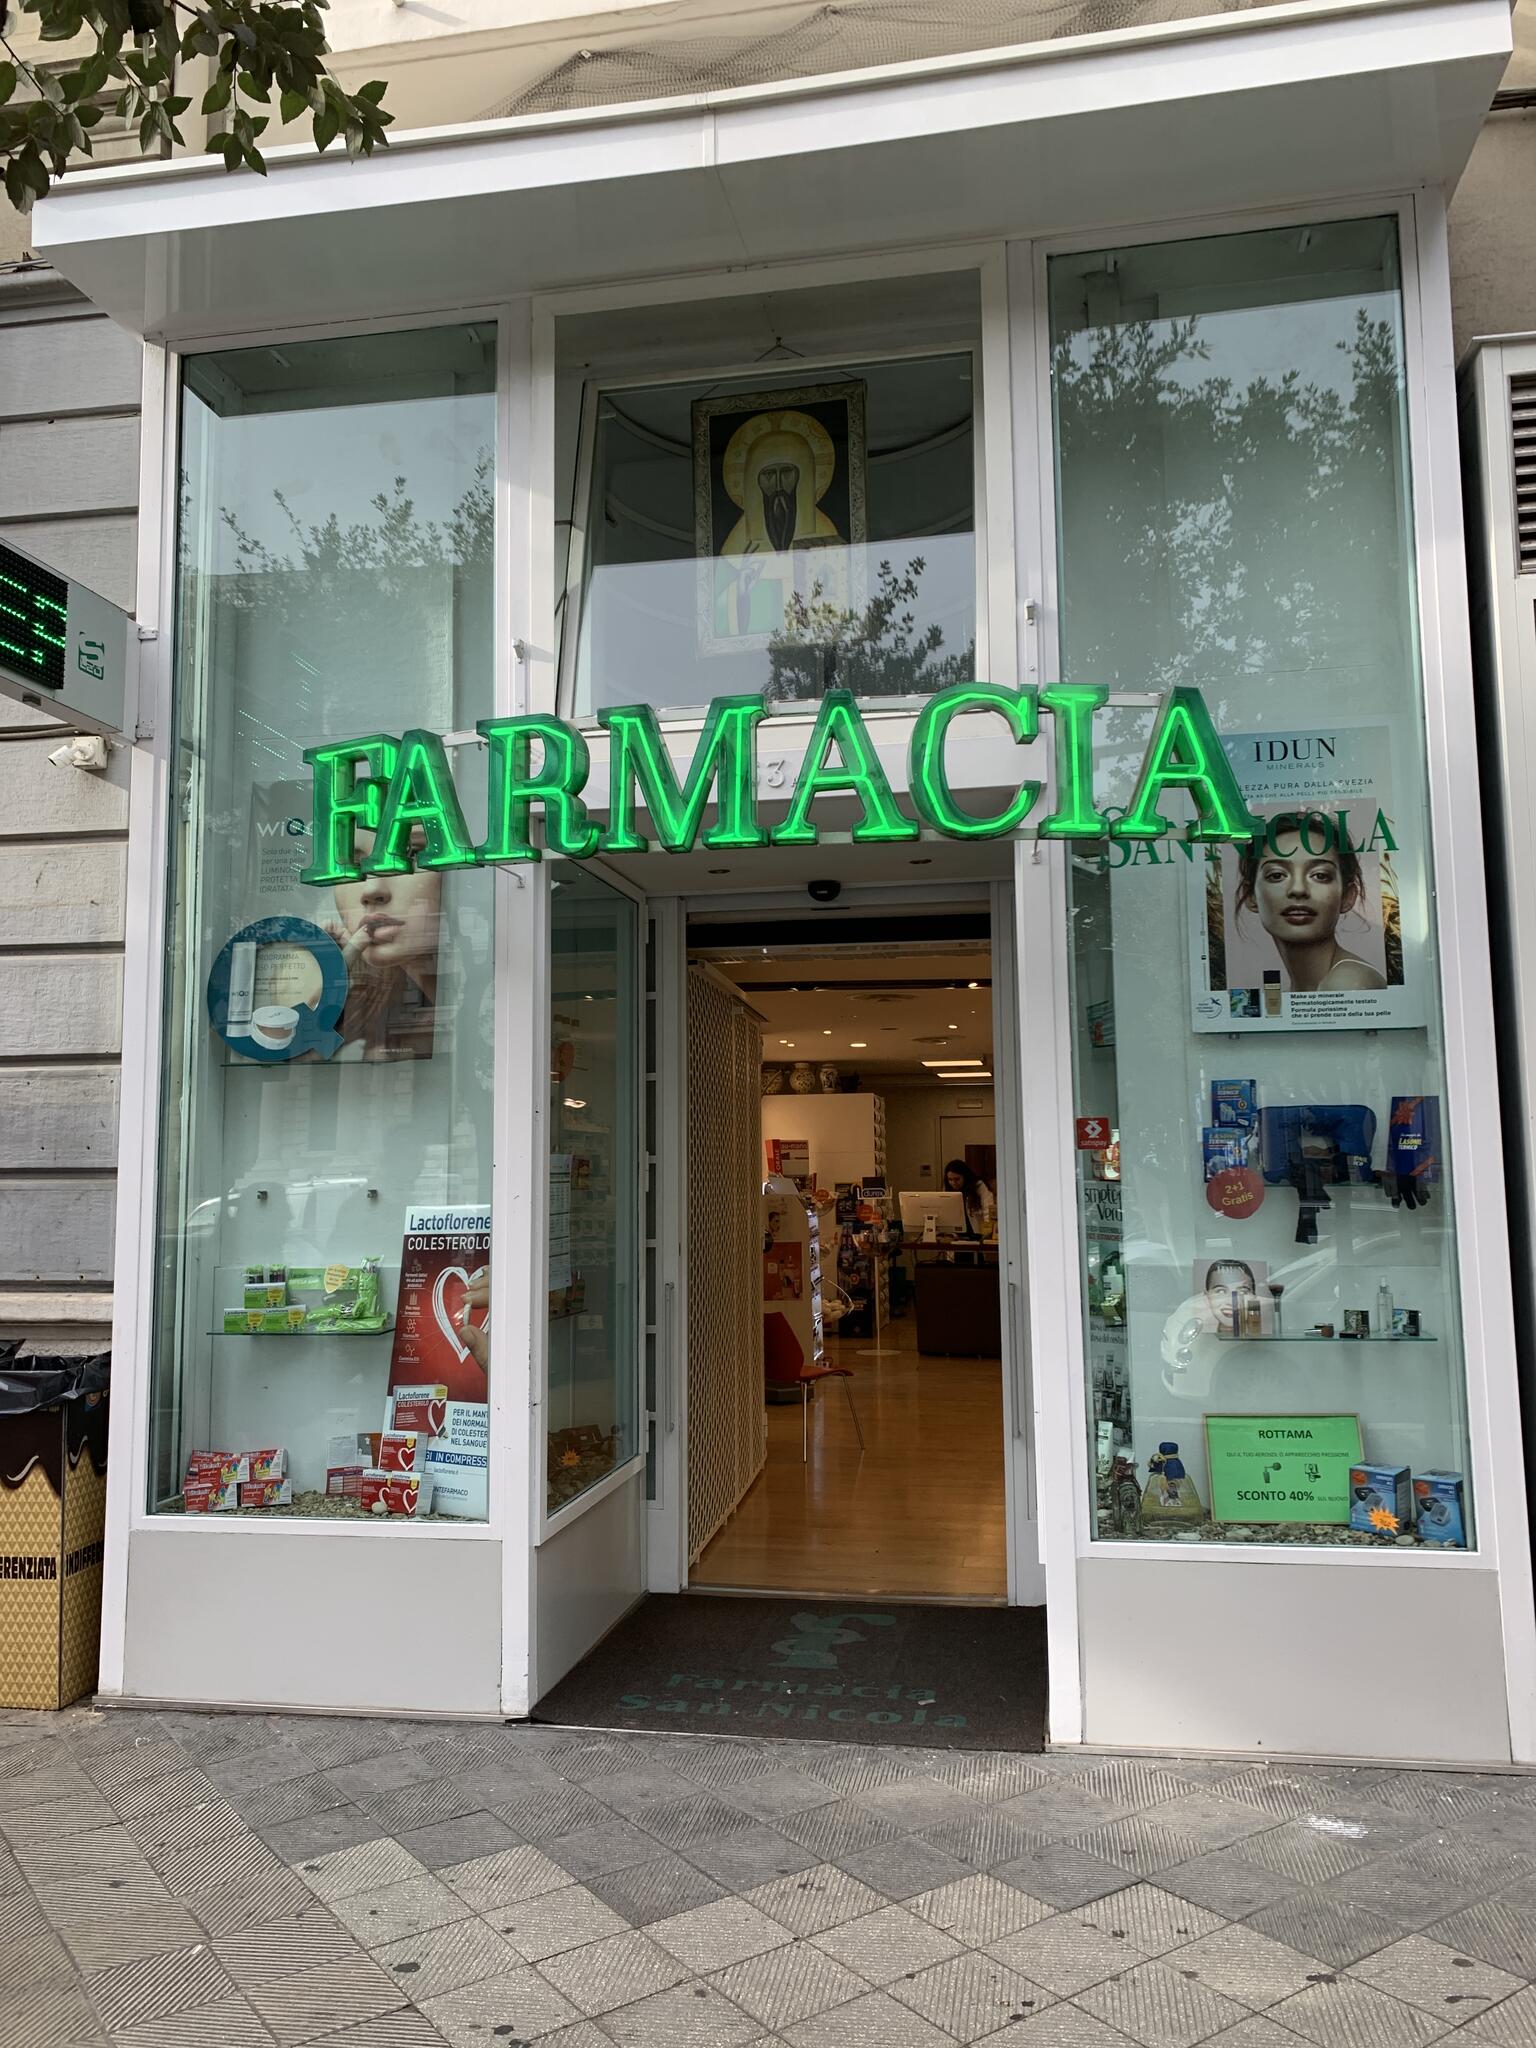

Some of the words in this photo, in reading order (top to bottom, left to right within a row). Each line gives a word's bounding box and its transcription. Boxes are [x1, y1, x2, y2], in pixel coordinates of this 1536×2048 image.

[1252, 737, 1337, 763] IDUN
[1266, 761, 1326, 771] MINERALS
[301, 681, 1264, 887] FARMACIA
[1239, 783, 1269, 792] LEZZA
[1273, 782, 1300, 790] PURA
[1304, 780, 1334, 788] DALLA
[256, 953, 300, 961] ROGRAMMA
[1224, 1181, 1245, 1195] 2+1
[1221, 1191, 1255, 1206] Gratis
[409, 1213, 491, 1231] Lactoflorene
[408, 1236, 490, 1251] COLESTEROLO
[453, 1408, 466, 1417] PER
[465, 1409, 472, 1418] IL
[452, 1418, 462, 1426] DEI
[451, 1427, 459, 1436] DI
[1258, 1429, 1313, 1439] ROTTAMA
[451, 1438, 462, 1446] NEL
[462, 1439, 488, 1448] SANGUE
[435, 1453, 444, 1462] IN
[445, 1453, 487, 1467] COMPRESS
[1236, 1490, 1286, 1501] SCONTO
[1289, 1490, 1315, 1502] 40%
[667, 1673, 937, 1700] Farmacia
[617, 1694, 732, 1715] San
[756, 1703, 968, 1727] Nicola
